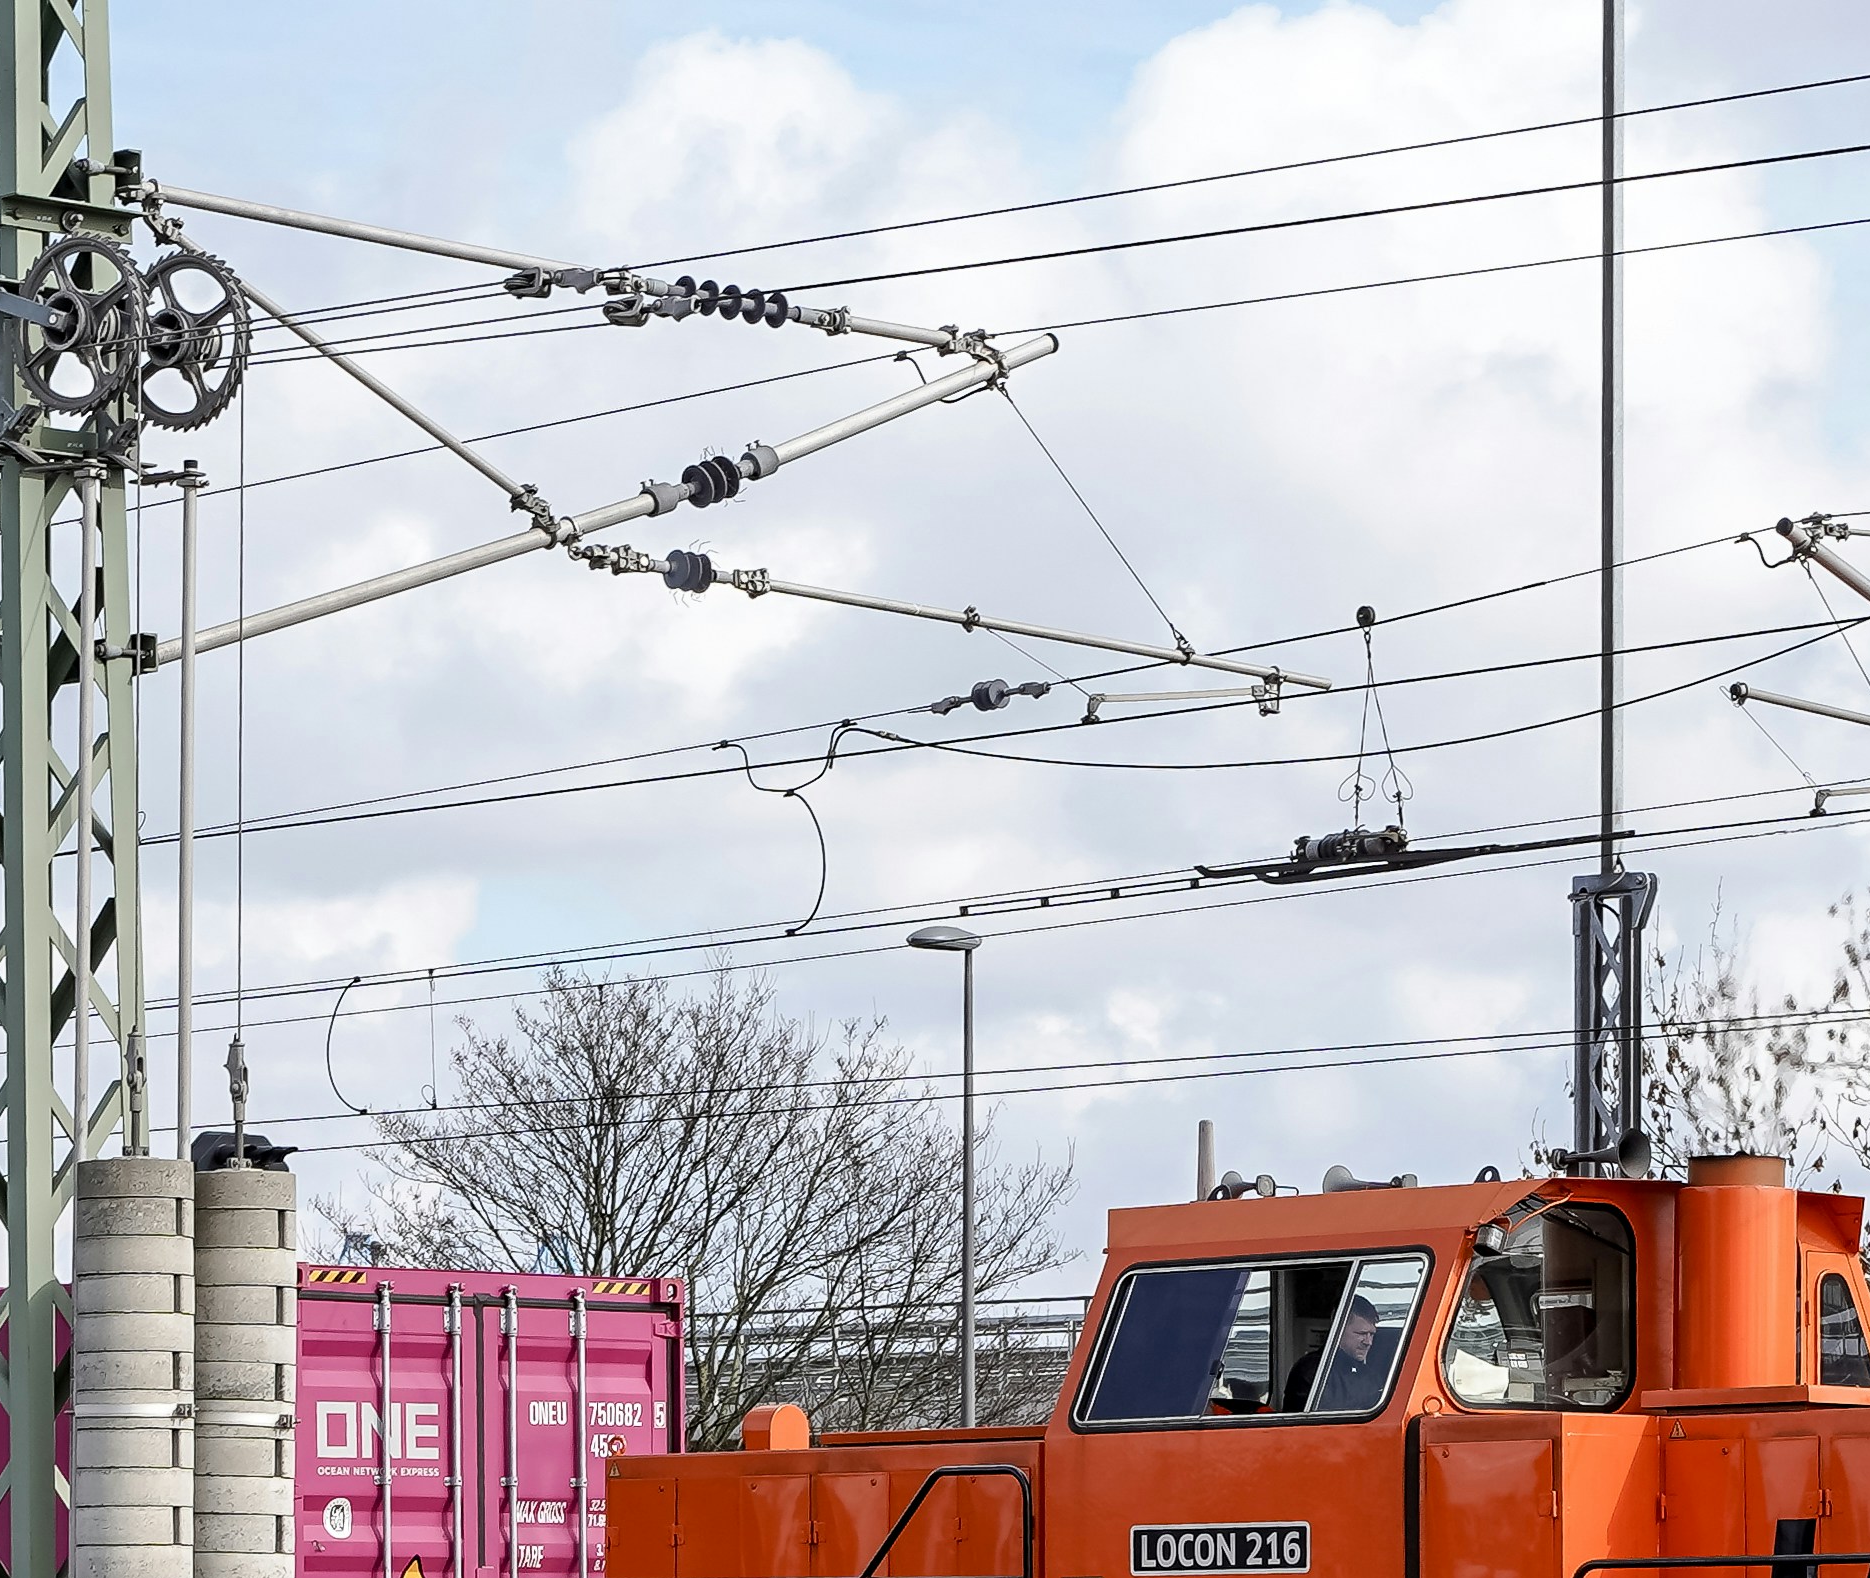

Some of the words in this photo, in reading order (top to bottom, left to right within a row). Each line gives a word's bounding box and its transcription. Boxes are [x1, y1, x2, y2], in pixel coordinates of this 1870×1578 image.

[529, 1401, 567, 1425] ONEU
[589, 1402, 643, 1427] 750682
[655, 1402, 666, 1428] 5
[316, 1401, 440, 1460] ONE
[590, 1434, 625, 1457] 45
[317, 1466, 351, 1475] OCEAN
[353, 1466, 398, 1476] NETWOK
[401, 1467, 440, 1477] EXPRESS
[538, 1502, 567, 1524] GROSS
[518, 1546, 544, 1568] TARE
[1141, 1533, 1236, 1567] LOCON
[1246, 1531, 1301, 1565] 216
